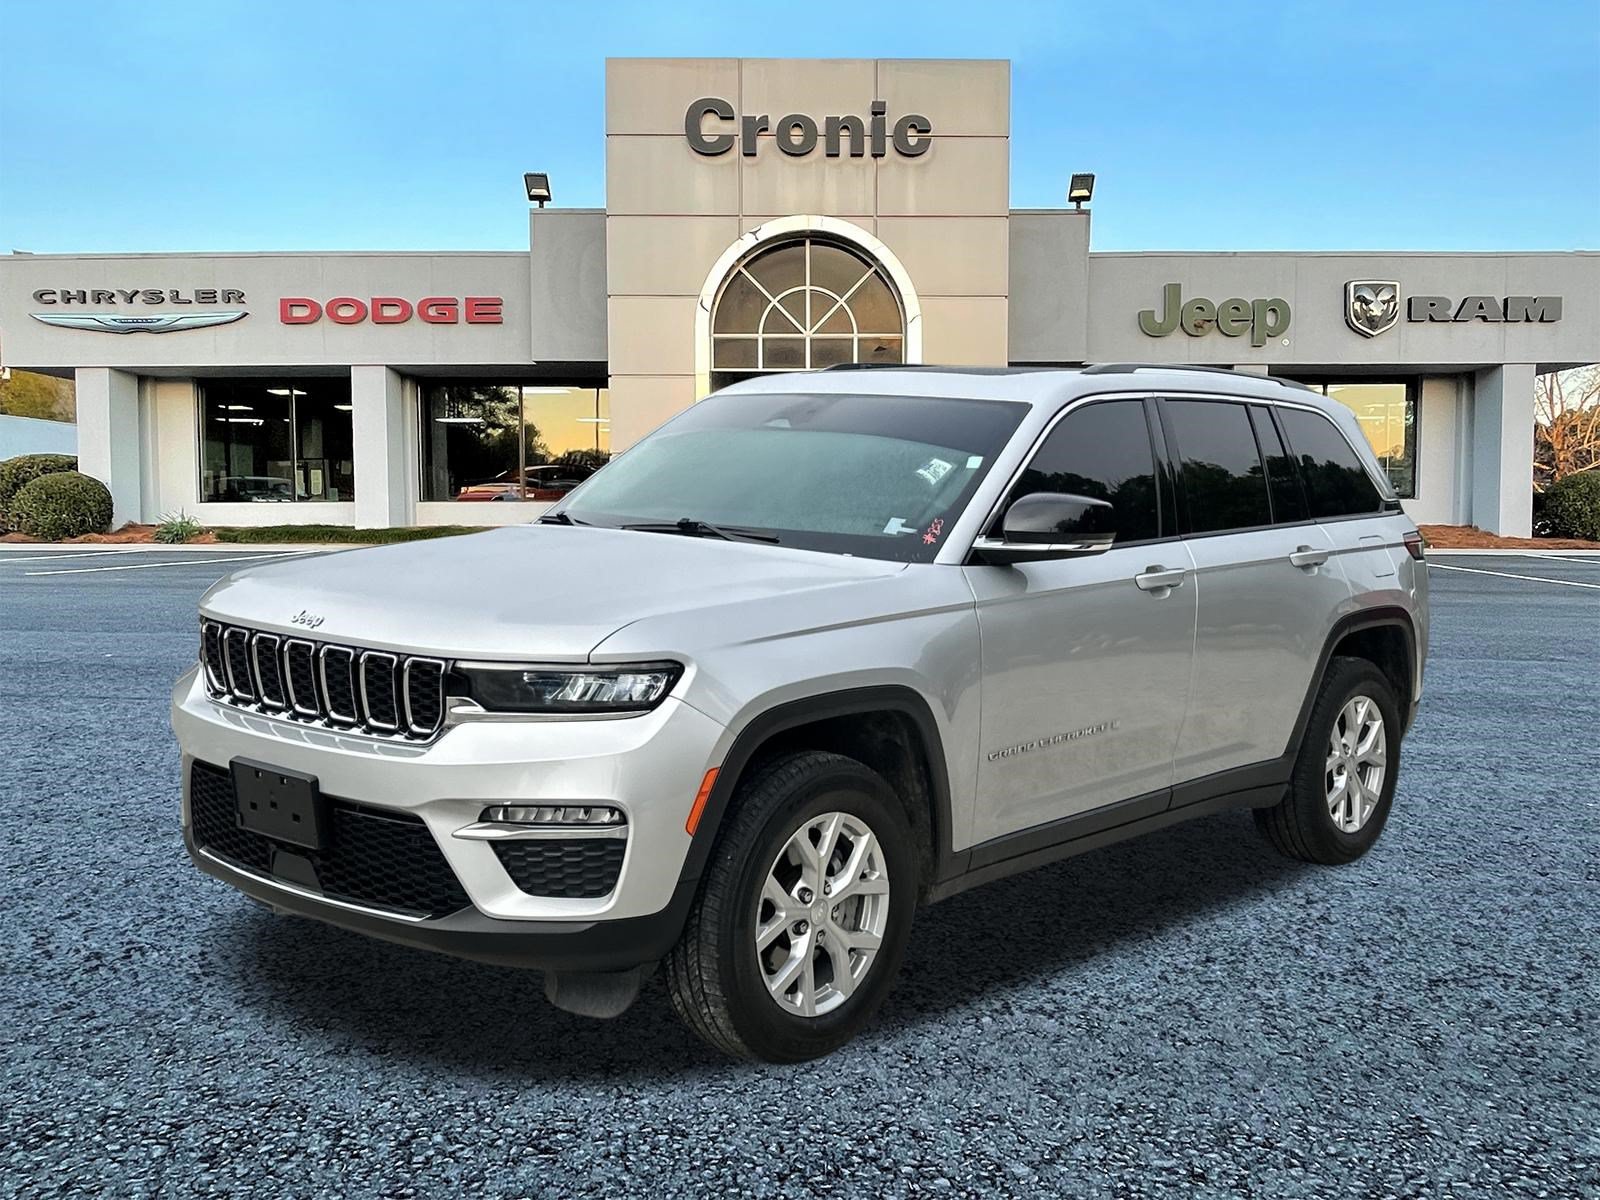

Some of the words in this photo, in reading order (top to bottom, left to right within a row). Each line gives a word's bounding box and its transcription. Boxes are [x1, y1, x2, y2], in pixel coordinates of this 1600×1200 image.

[685, 97, 932, 158] Cronic
[32, 289, 246, 305] CHRYSLER
[280, 297, 504, 325] DODGE
[1407, 296, 1563, 323] RAM
[1138, 283, 1292, 348] Jeep
[290, 609, 325, 629] Jeep
[987, 741, 1037, 761] GRAND
[1039, 723, 1108, 748] CHEROKEE
